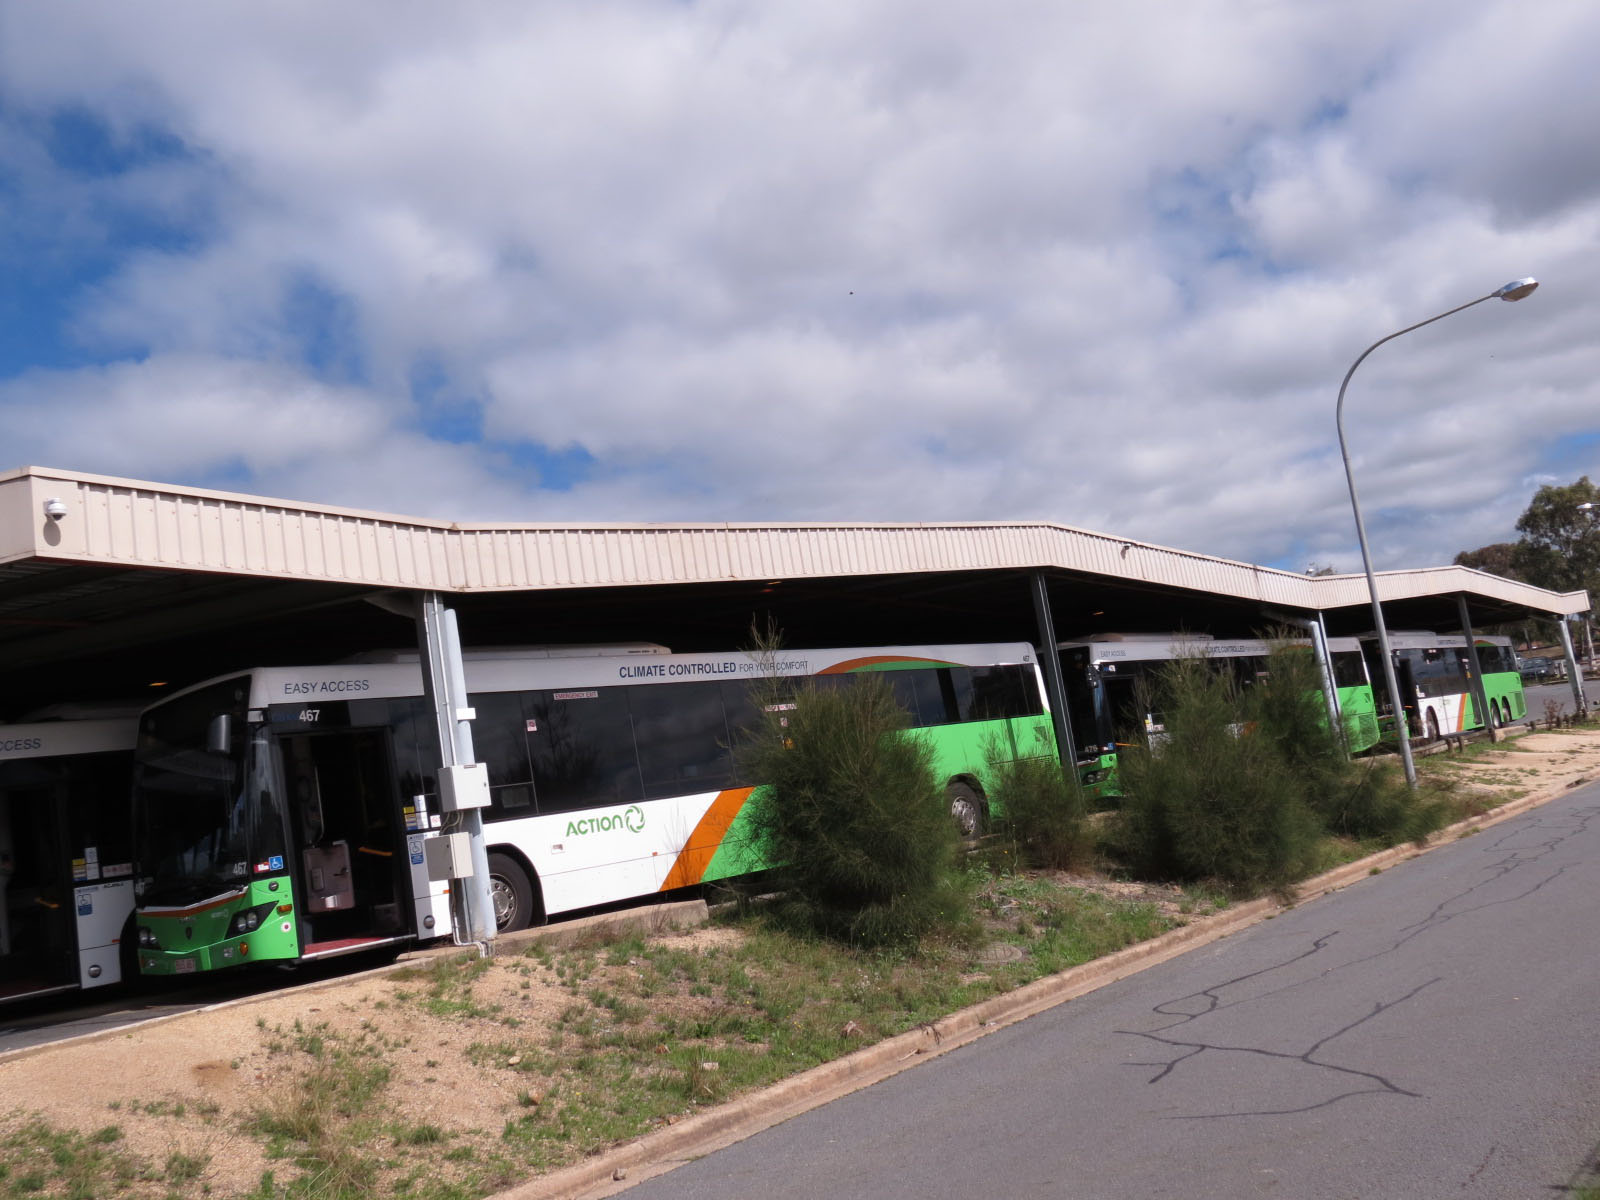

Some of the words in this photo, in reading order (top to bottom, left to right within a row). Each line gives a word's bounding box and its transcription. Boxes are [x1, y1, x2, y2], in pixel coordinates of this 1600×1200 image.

[619, 664, 666, 679] CLIMATE
[668, 662, 737, 676] CONTROLLED
[739, 663, 754, 673] FOR
[756, 662, 775, 672] YOUR
[776, 660, 809, 671] COMFORT
[284, 682, 318, 695] EASY
[320, 679, 370, 692] ACCESS
[299, 709, 320, 722] 467
[565, 814, 624, 837] ACTION
[232, 861, 247, 876] 467
